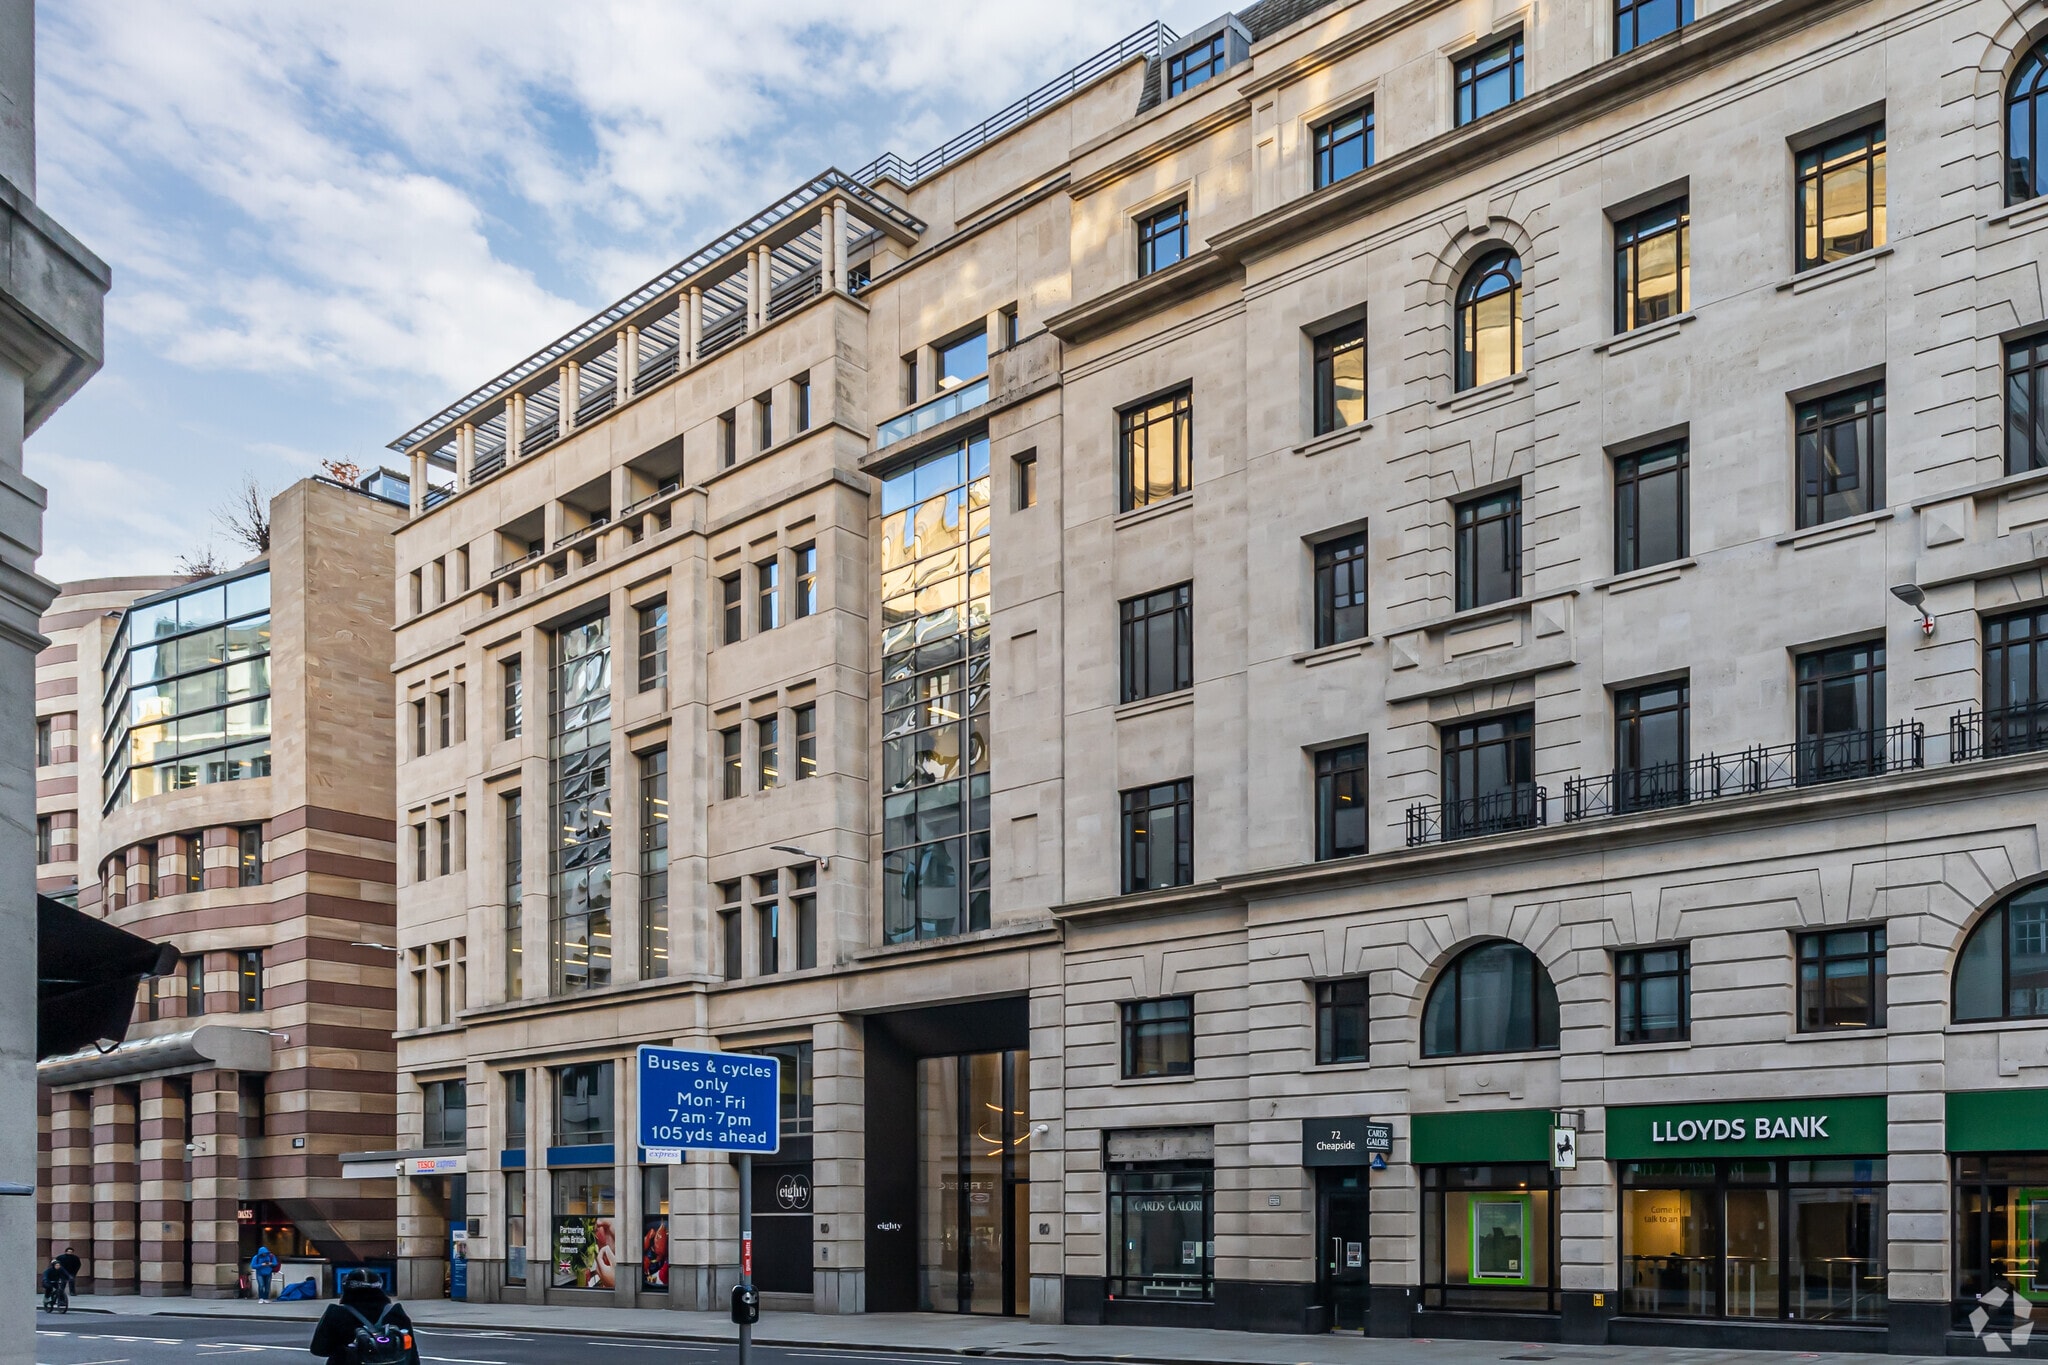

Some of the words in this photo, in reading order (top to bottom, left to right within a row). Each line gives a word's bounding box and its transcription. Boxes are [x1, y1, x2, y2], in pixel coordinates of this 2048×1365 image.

[648, 1055, 700, 1072] Buses
[706, 1060, 716, 1073] &
[722, 1064, 771, 1078] cycles
[694, 1078, 728, 1094] only
[677, 1092, 713, 1107] Mon
[725, 1095, 745, 1109] Fri
[1367, 1128, 1388, 1138] CARDS
[1653, 1119, 1746, 1142] LLOYDS
[1755, 1116, 1829, 1139] BANK
[652, 1126, 682, 1140] 105
[685, 1128, 713, 1143] yds
[719, 1129, 767, 1144] ahead
[1331, 1130, 1341, 1140] 72
[1316, 1140, 1356, 1152] Cheapside
[1366, 1137, 1389, 1147] GALORE
[416, 1160, 435, 1169] TESCO
[779, 1184, 809, 1201] eighty
[1134, 1200, 1165, 1212] CARDS
[1650, 1206, 1673, 1214] Come
[1644, 1215, 1658, 1223] talk
[560, 1225, 585, 1236] Partnering
[876, 1222, 902, 1231] eighty
[1039, 1223, 1050, 1235] 80
[571, 1235, 586, 1243] British
